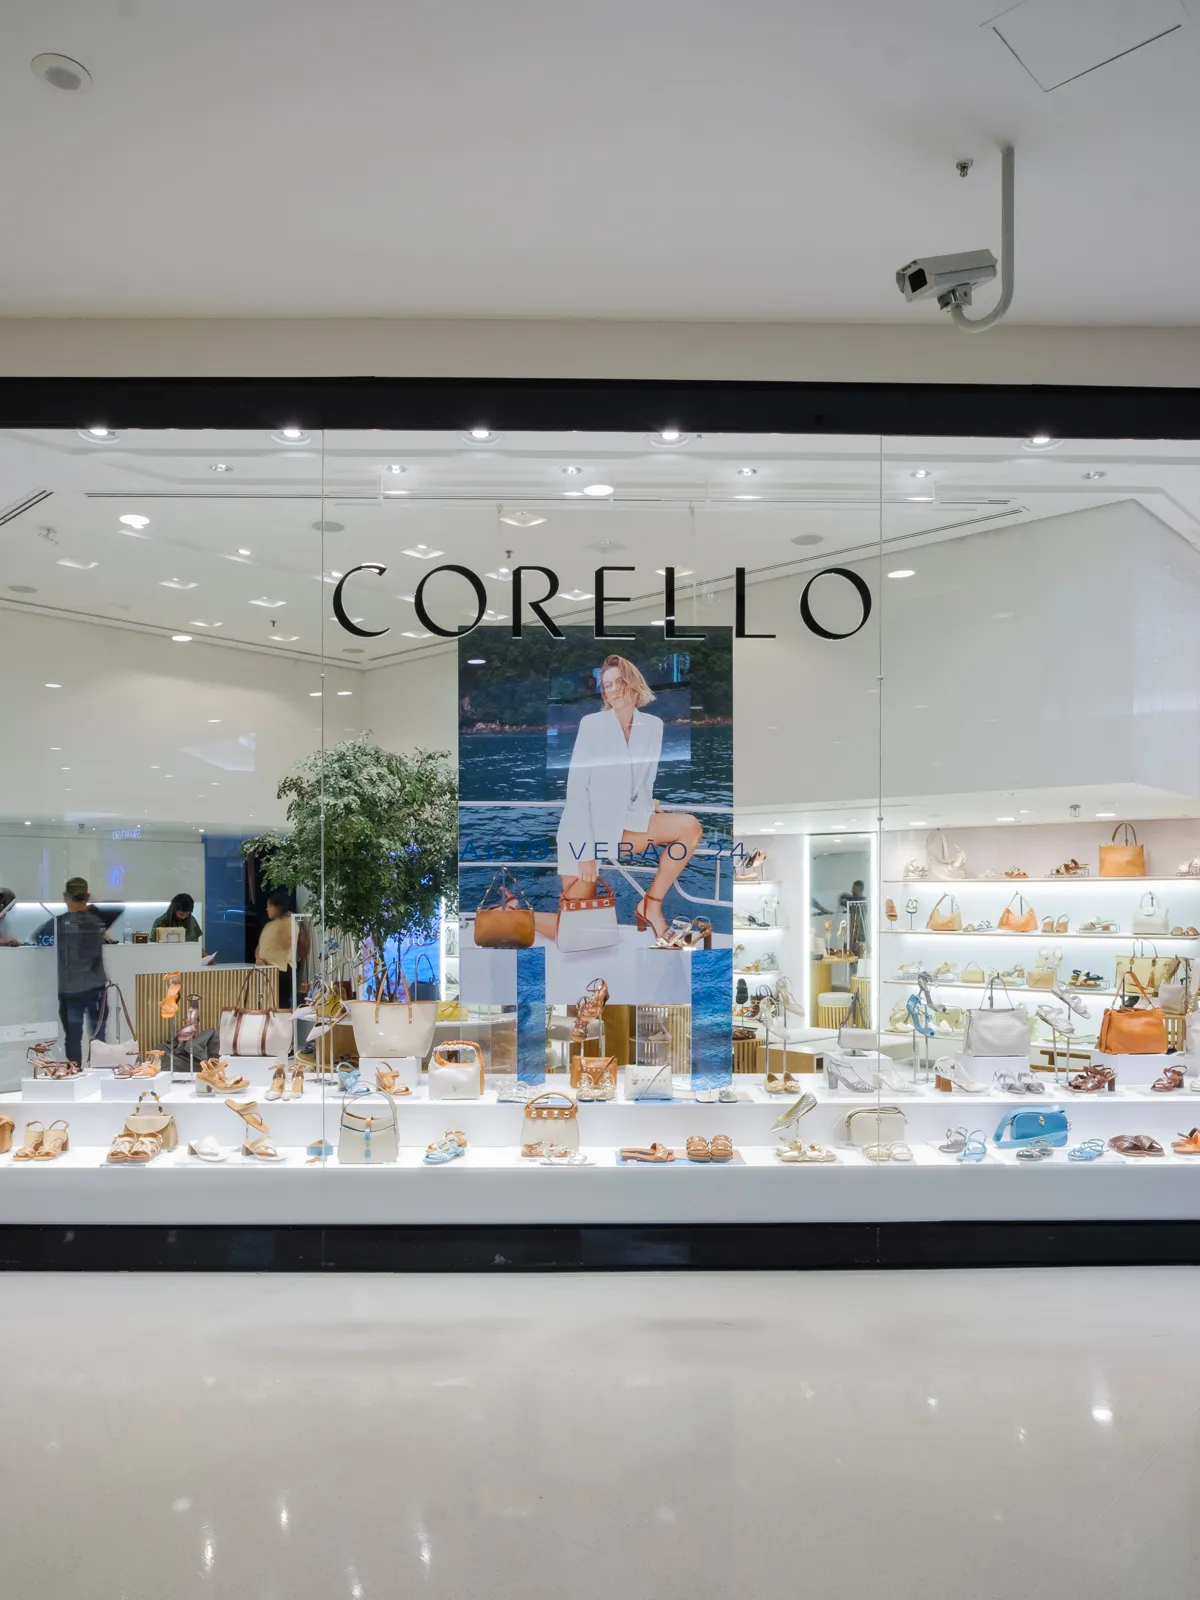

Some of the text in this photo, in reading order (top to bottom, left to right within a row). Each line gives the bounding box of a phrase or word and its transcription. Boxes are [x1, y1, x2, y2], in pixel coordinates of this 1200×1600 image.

[332, 564, 872, 640] CORELLO
[460, 839, 746, 861] ALTO VERÃO 24
